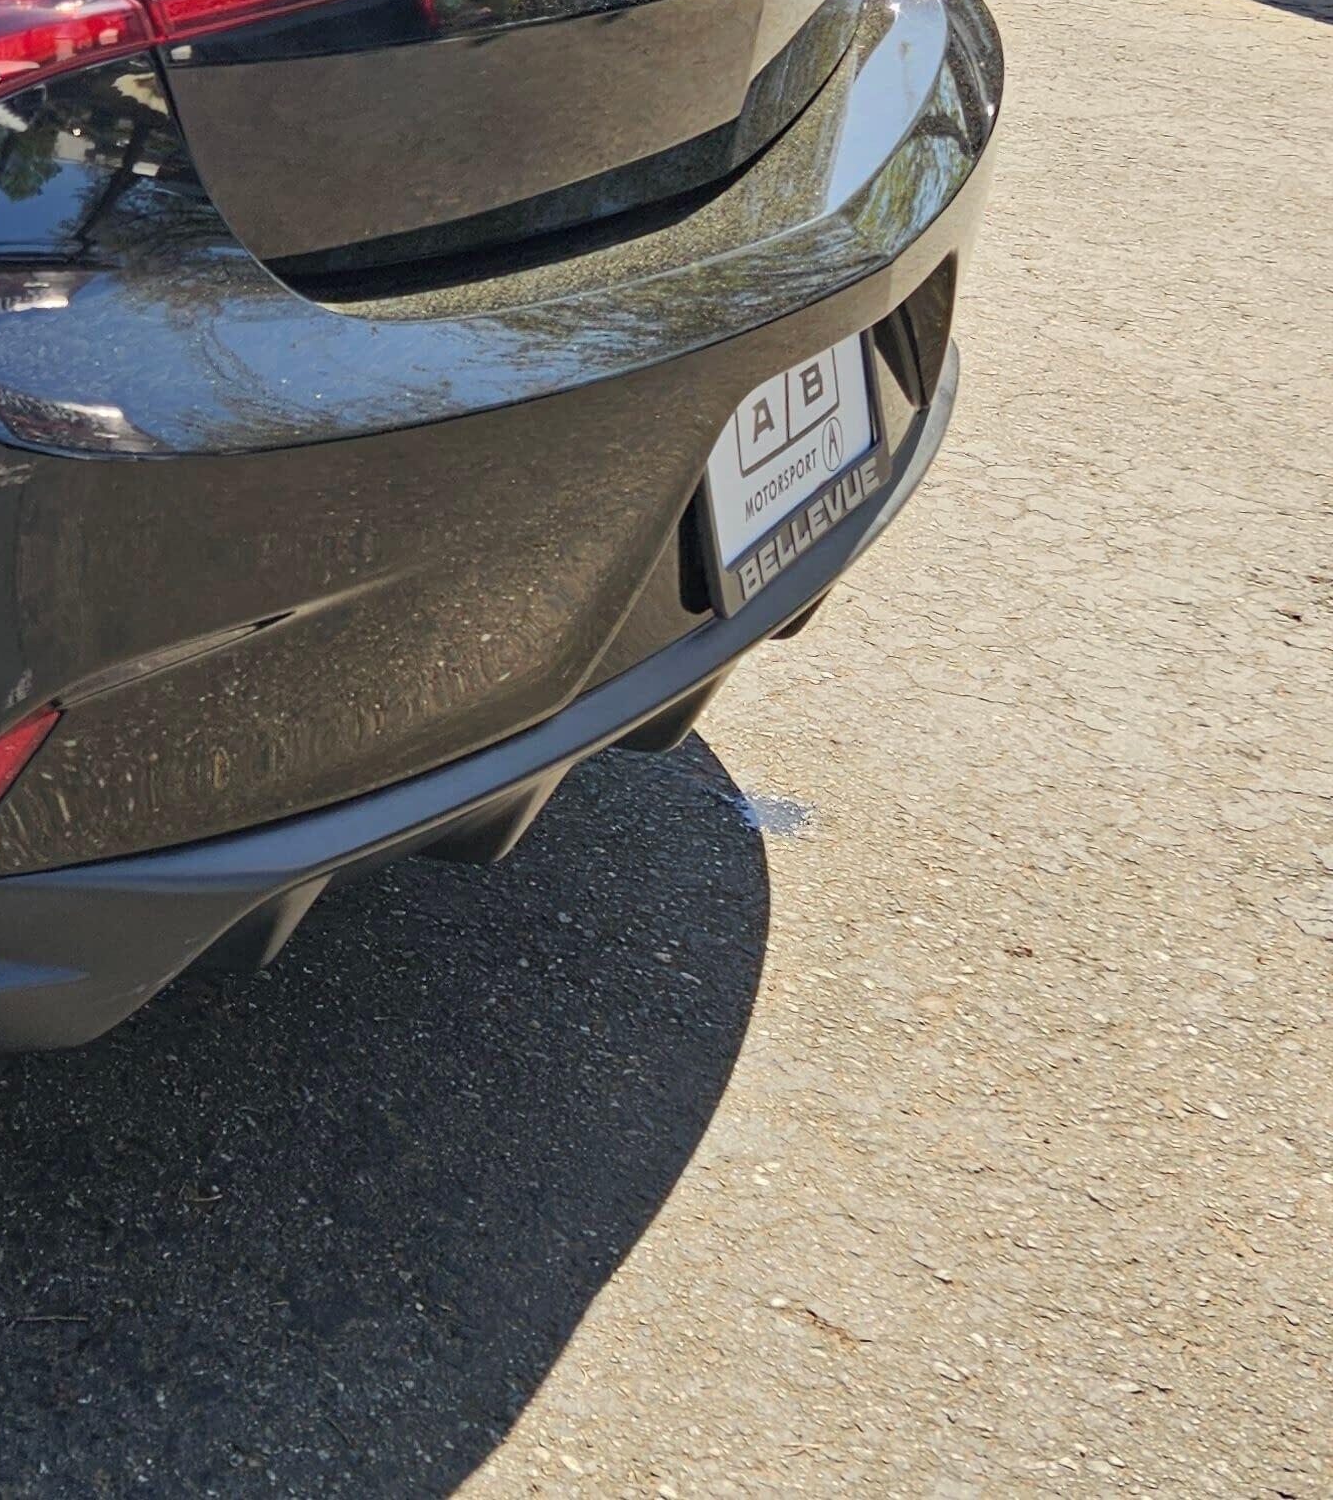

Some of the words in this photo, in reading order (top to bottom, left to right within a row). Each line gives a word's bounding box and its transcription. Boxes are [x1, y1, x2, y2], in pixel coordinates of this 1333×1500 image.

[753, 397, 776, 445] A
[799, 362, 824, 407] B
[745, 447, 817, 524] MOTORSPORT
[737, 456, 881, 602] BELLEVUE
